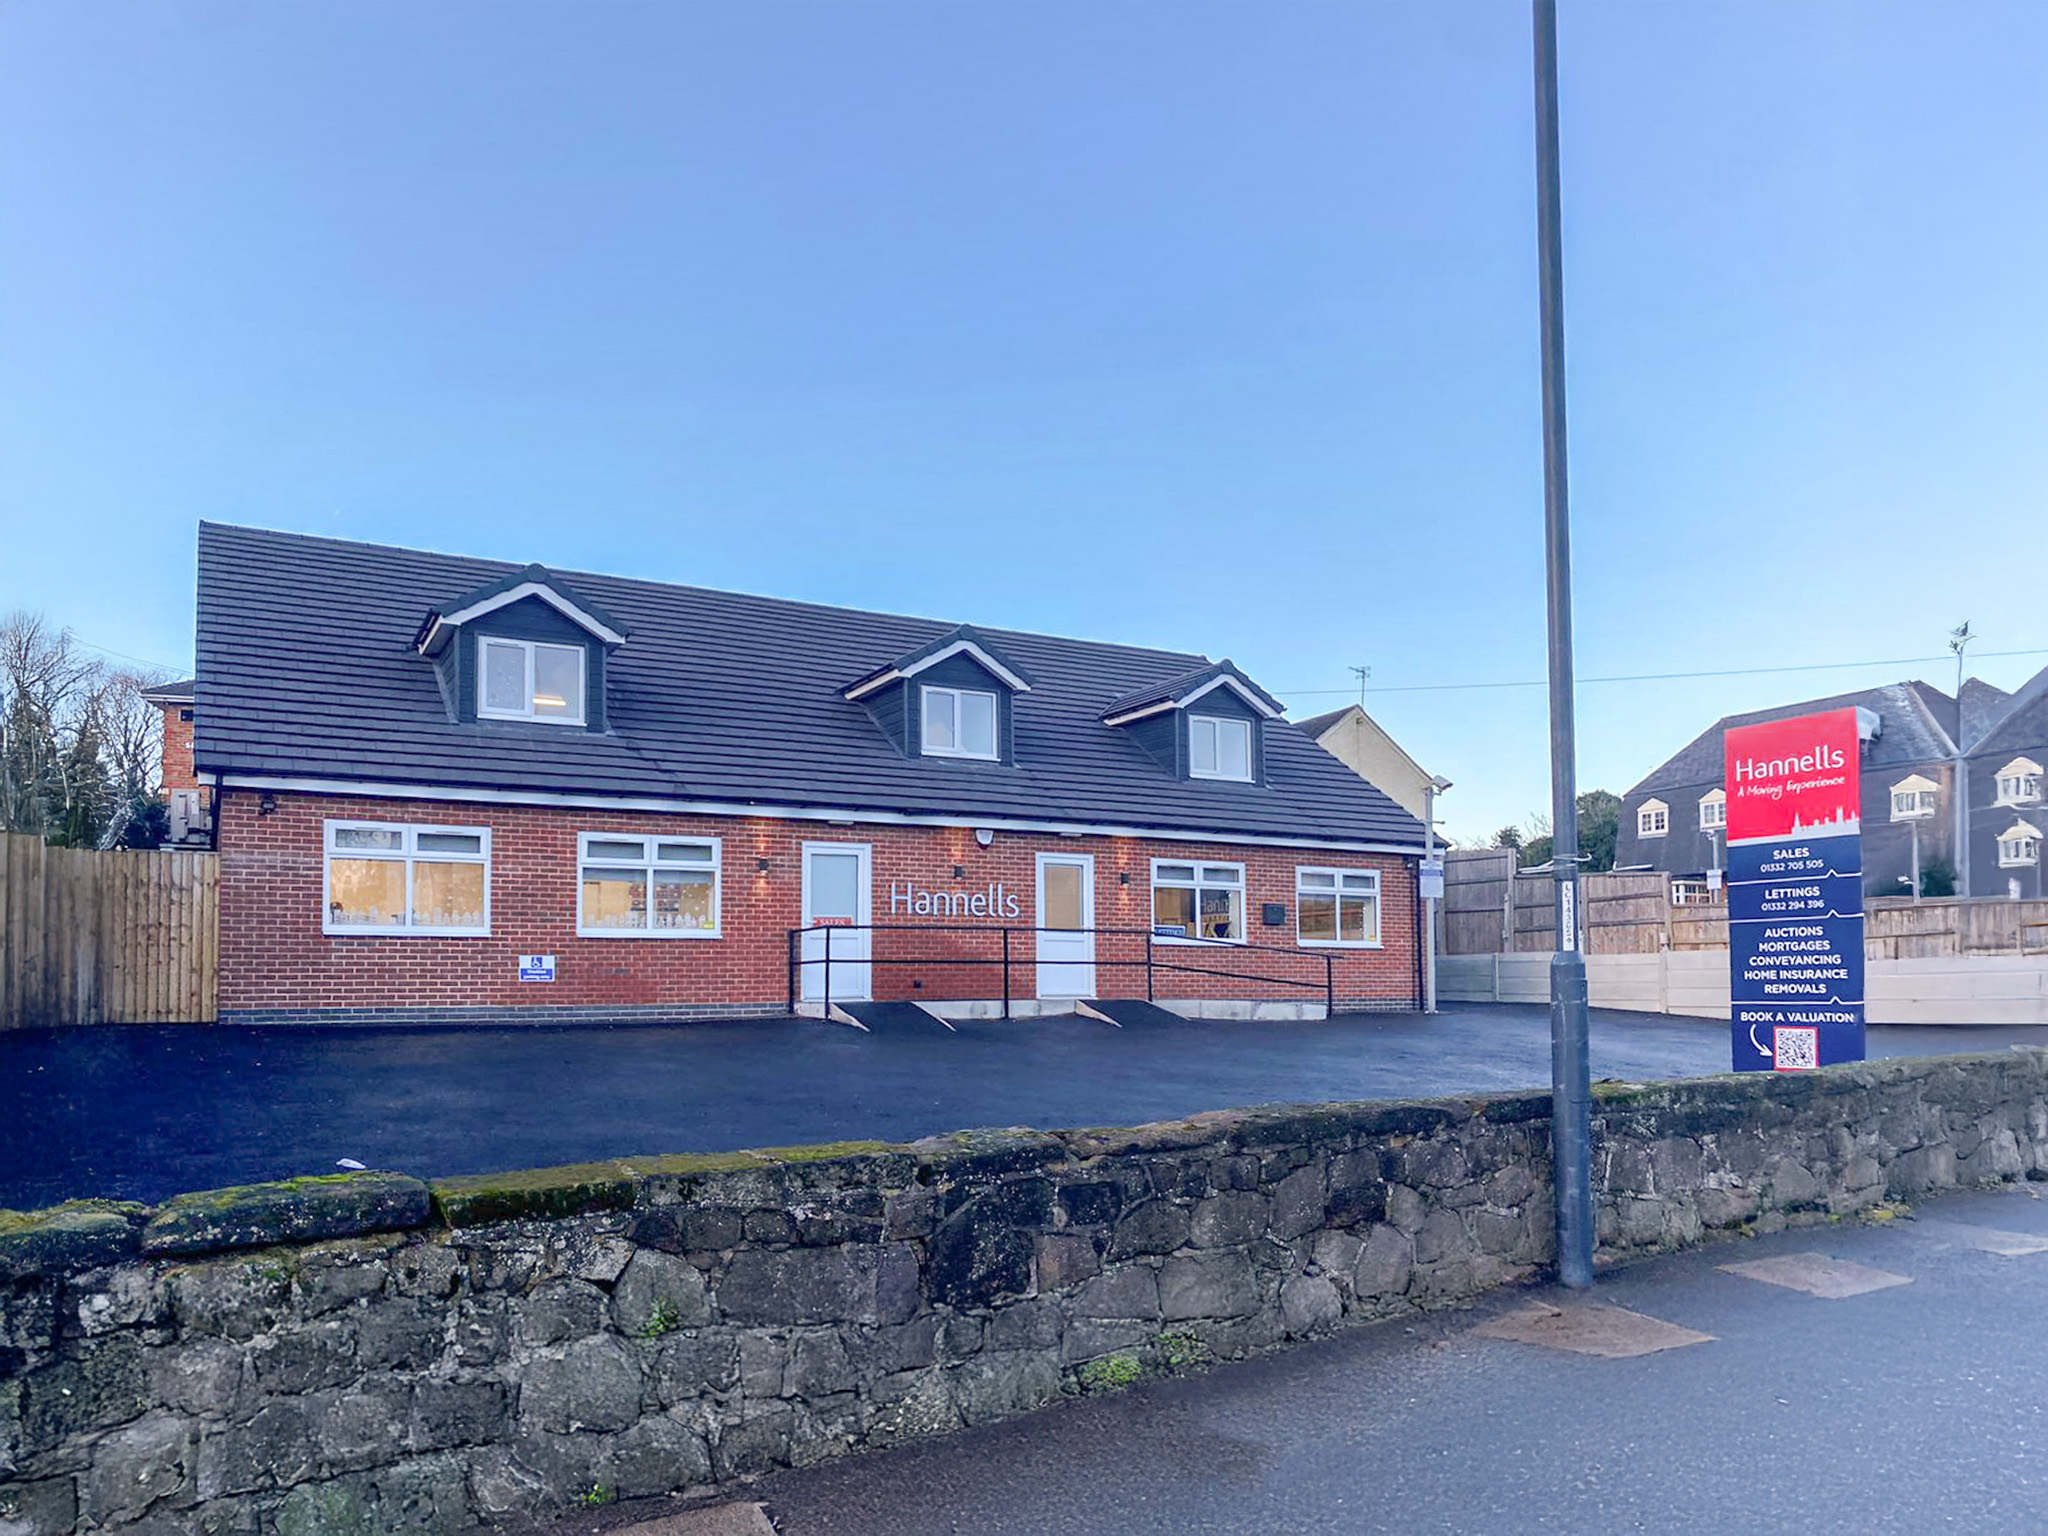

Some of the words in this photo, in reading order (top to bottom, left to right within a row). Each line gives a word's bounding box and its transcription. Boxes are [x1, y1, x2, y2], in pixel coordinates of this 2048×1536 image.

[1735, 744, 1845, 782] Hannells
[1738, 785, 1745, 798] A
[1747, 783, 1783, 800] Moving
[1786, 776, 1845, 794] Experience
[1773, 847, 1810, 860] SALES
[1760, 862, 1786, 873] 01332
[1787, 861, 1804, 871] 705
[1805, 859, 1824, 869] 505
[1765, 886, 1820, 900] LETTINGS
[890, 882, 1020, 918] Hannells
[1761, 901, 1787, 912] 01332
[1788, 900, 1805, 911] 294
[1807, 899, 1825, 909] 396
[1764, 926, 1824, 938] AUCTIONS
[1758, 940, 1831, 952] MORTGAGES
[1749, 954, 1842, 967] CONVEYANCING
[1744, 970, 1777, 980] HOME
[1779, 968, 1848, 980] INSURANCE
[1764, 983, 1827, 994] REMOVALS
[1740, 1011, 1773, 1022] BOOK
[1775, 1012, 1784, 1022] A
[1786, 1012, 1855, 1023] VALUATION
